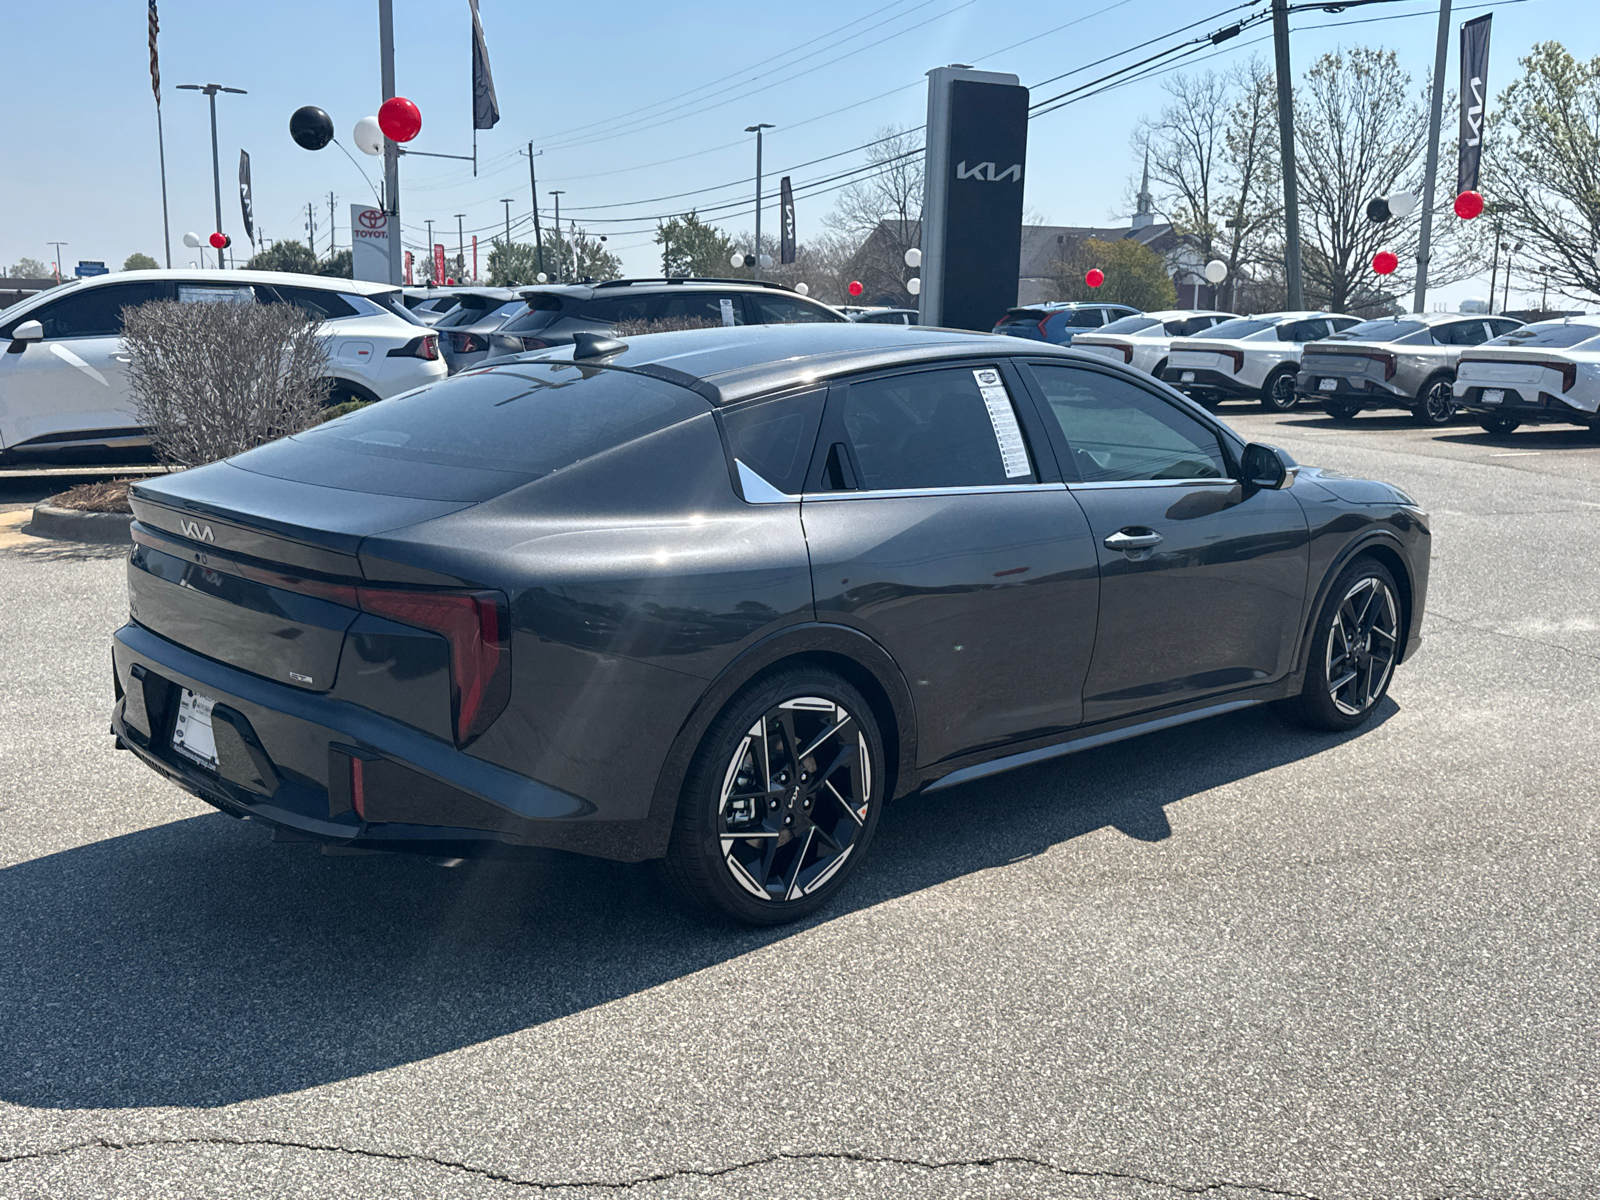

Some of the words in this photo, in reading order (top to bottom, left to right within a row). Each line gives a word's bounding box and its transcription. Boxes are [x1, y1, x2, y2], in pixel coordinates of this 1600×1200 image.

[1466, 76, 1482, 147] KIA
[957, 160, 1021, 182] KIA
[180, 519, 215, 543] KIA
